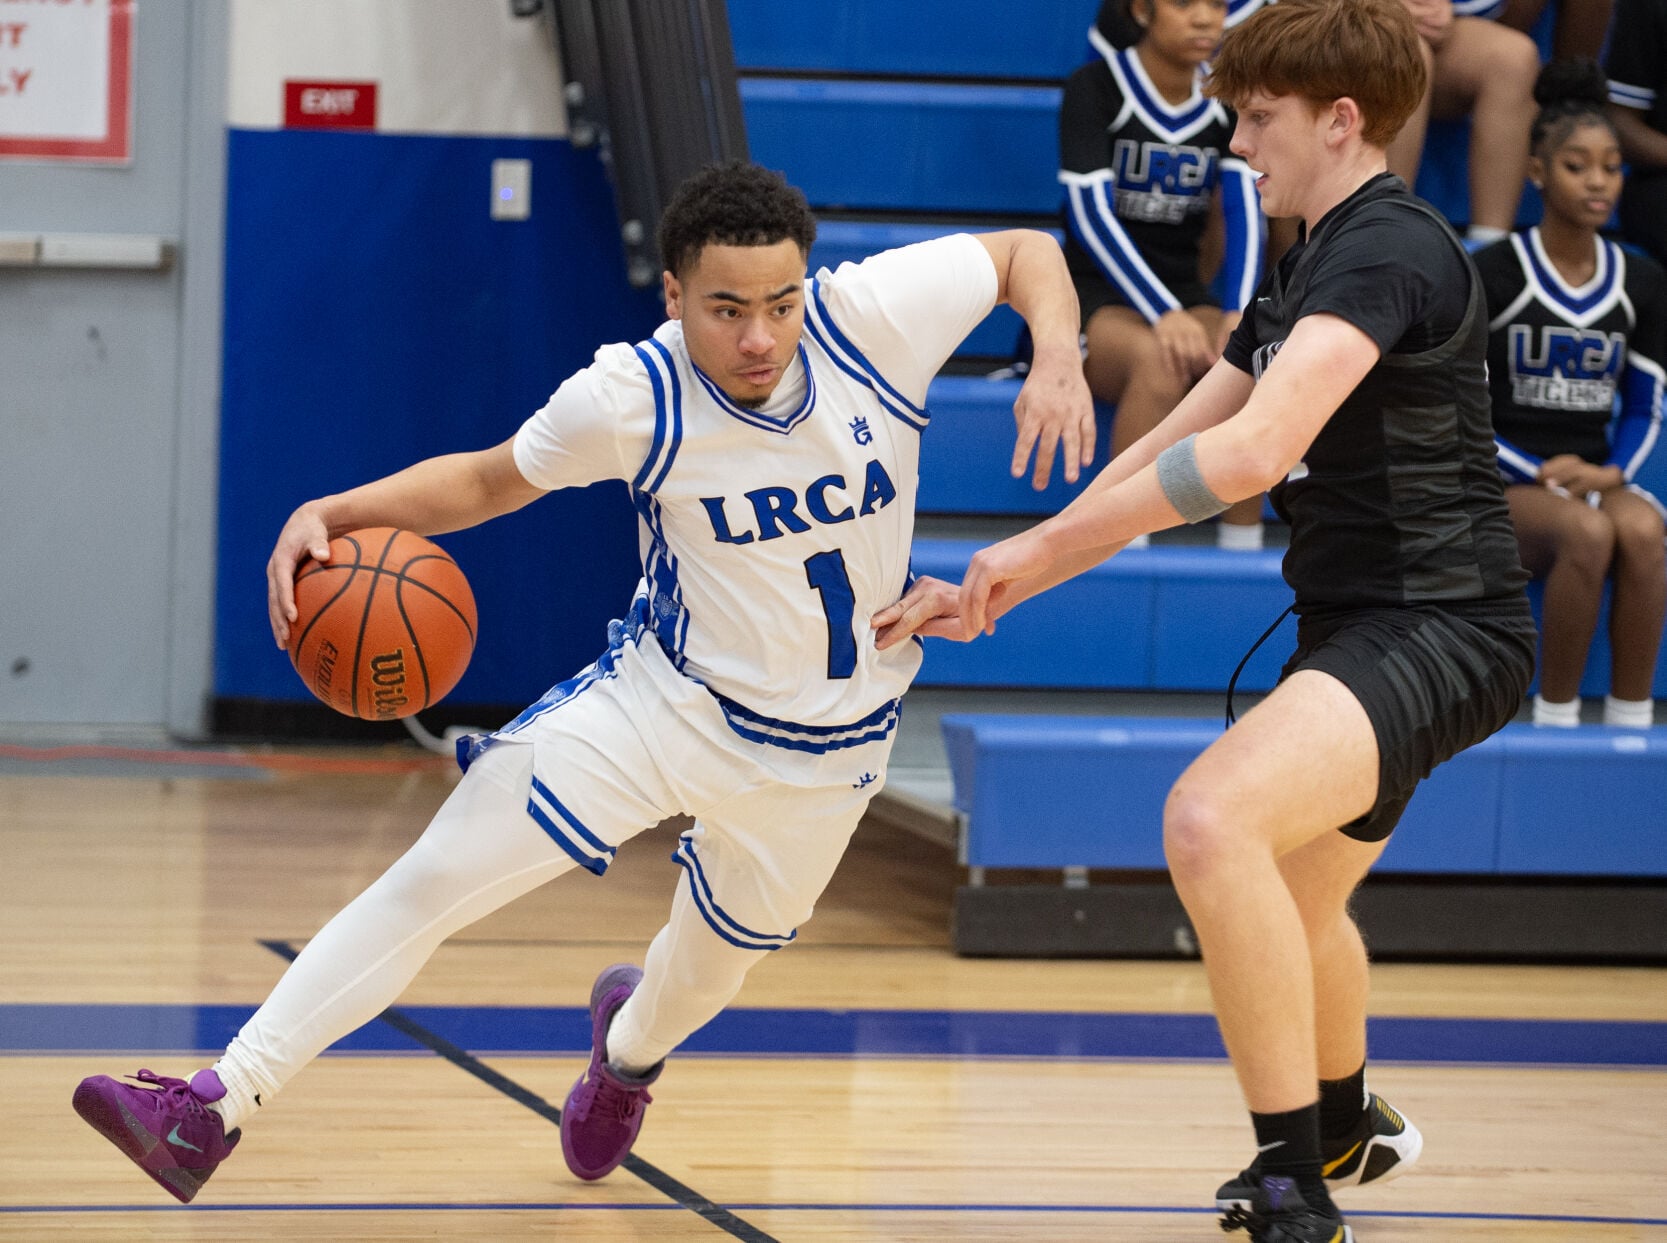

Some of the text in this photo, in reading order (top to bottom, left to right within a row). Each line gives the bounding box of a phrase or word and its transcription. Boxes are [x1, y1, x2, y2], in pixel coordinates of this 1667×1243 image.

[301, 88, 360, 115] EXIT
[699, 459, 896, 545] LRCA
[803, 548, 858, 680] 1
